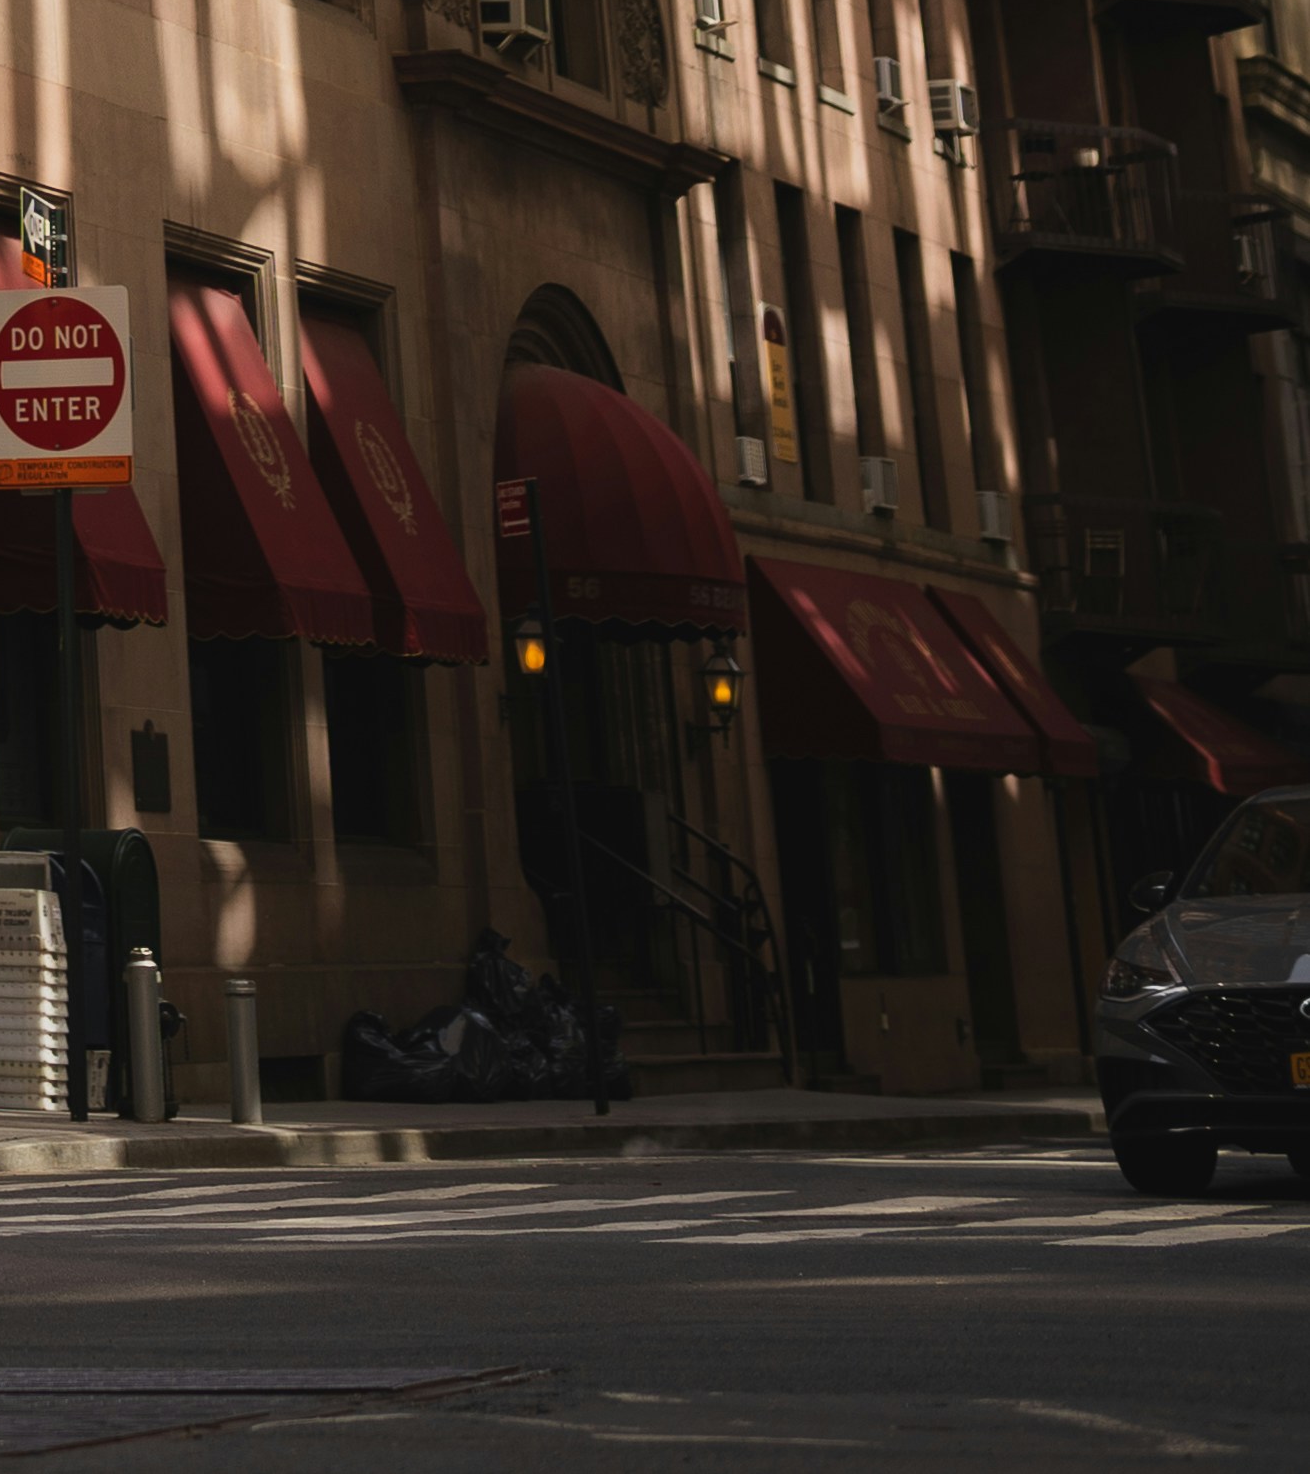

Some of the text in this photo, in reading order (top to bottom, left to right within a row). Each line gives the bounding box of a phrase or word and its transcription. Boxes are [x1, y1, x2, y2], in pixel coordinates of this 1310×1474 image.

[11, 324, 102, 351] DO NOT
[15, 396, 101, 422] ENTER
[17, 460, 126, 470] TEMPORARY CONSTRUCTION
[17, 471, 68, 480] REGULATION
[567, 577, 601, 599] 56
